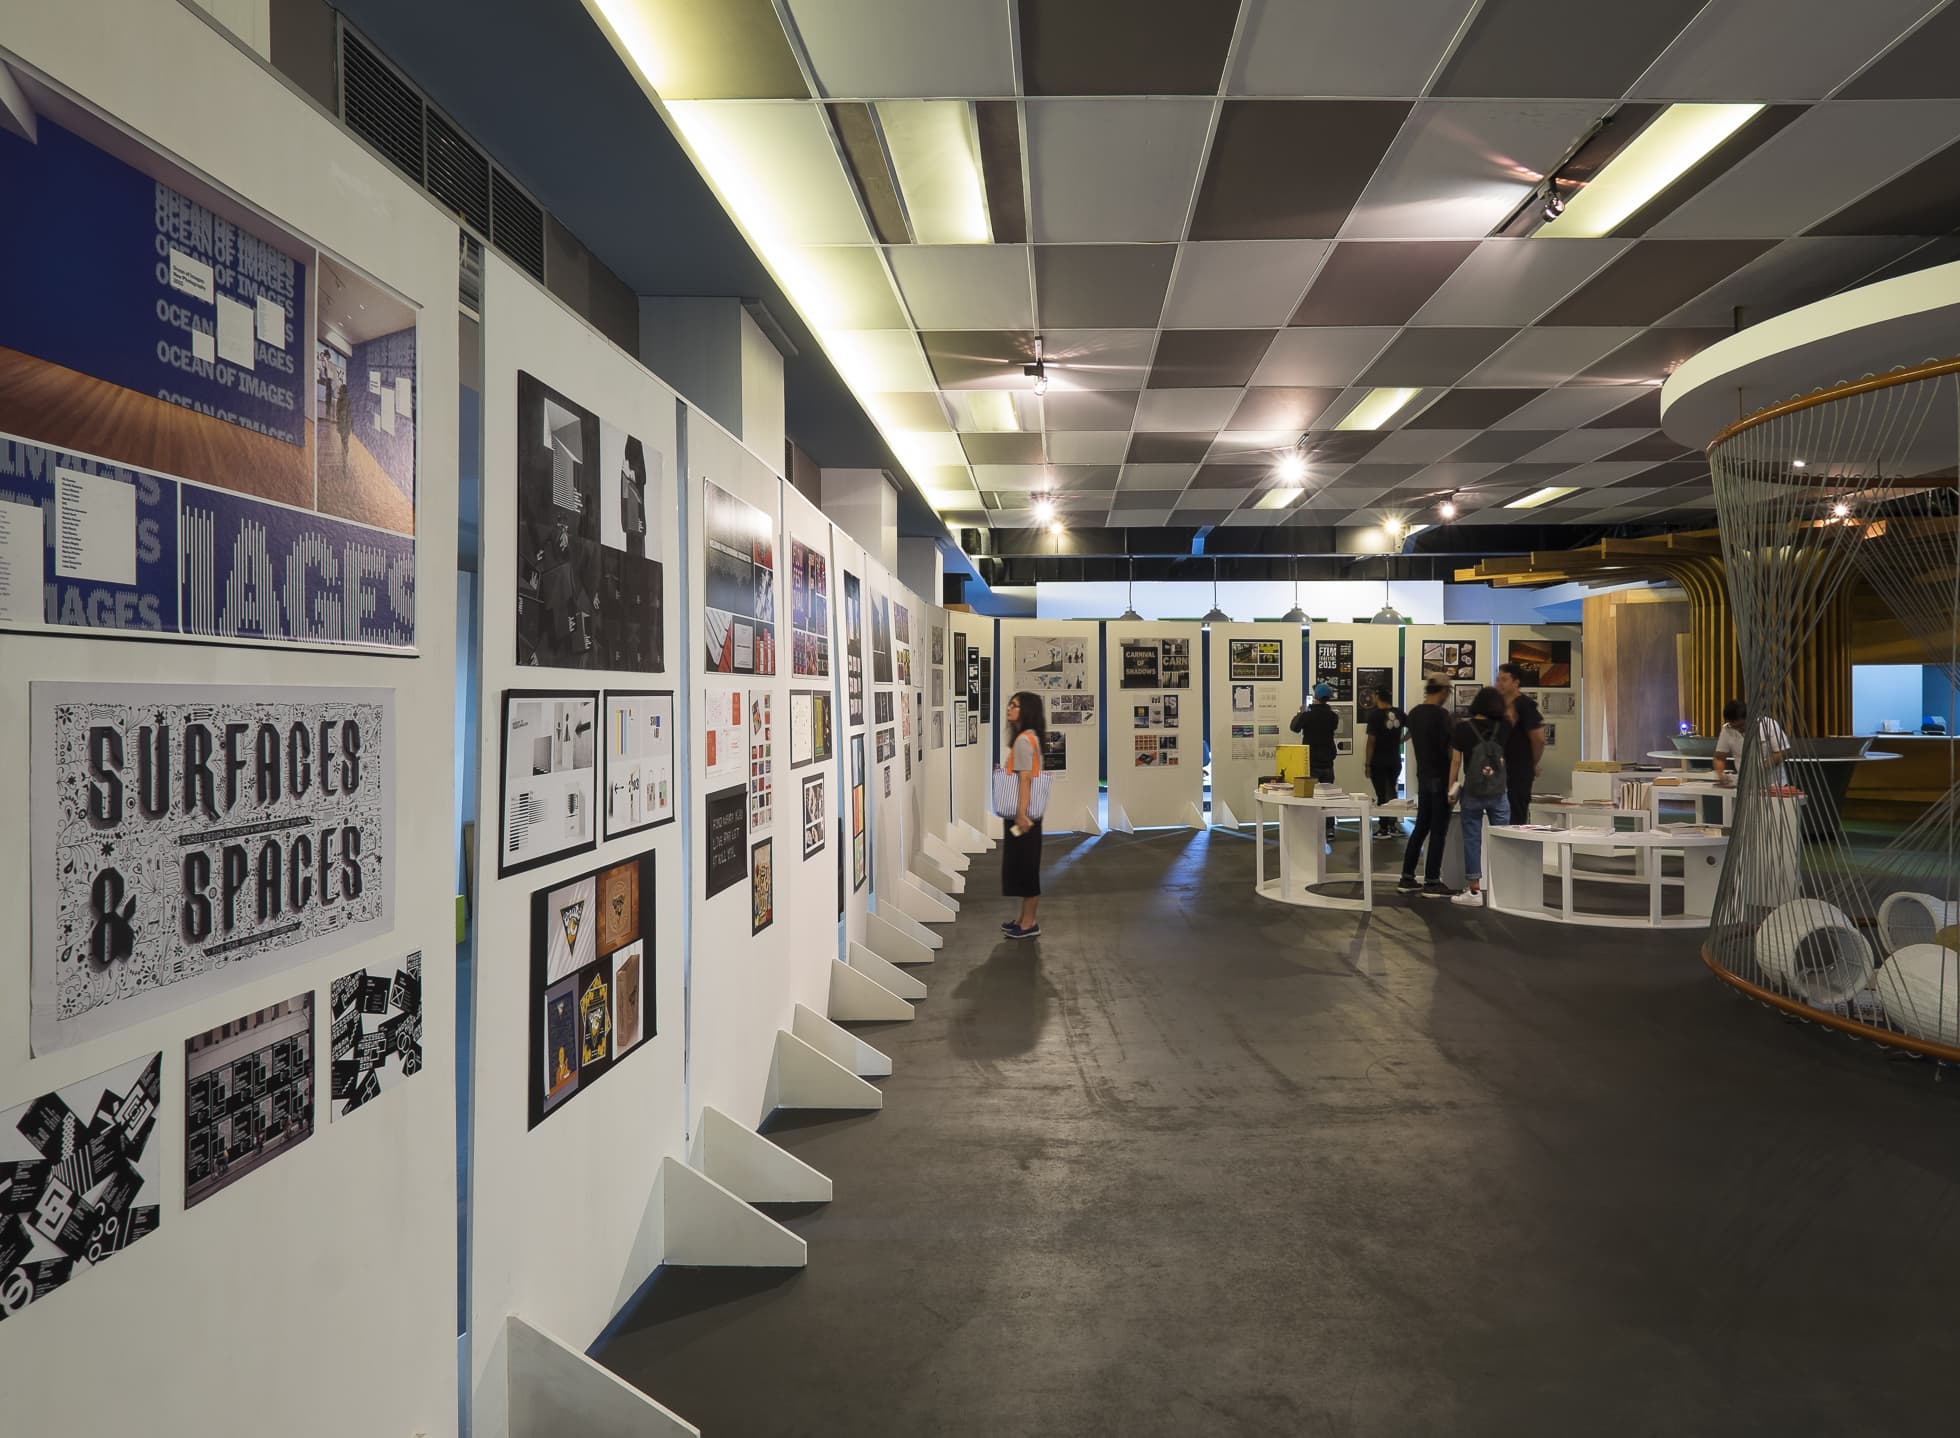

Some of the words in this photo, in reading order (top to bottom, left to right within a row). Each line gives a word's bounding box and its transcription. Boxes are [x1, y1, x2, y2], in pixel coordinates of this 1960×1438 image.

[157, 299, 214, 336] OCEAN
[157, 341, 214, 380] OCEAN
[216, 364, 237, 388] OF
[239, 372, 295, 411] IMAGES
[254, 340, 295, 374] AGES
[1319, 661, 1337, 669] 2015
[88, 720, 361, 830] SURFACES
[90, 866, 137, 973] &
[183, 826, 362, 944] SPACES
